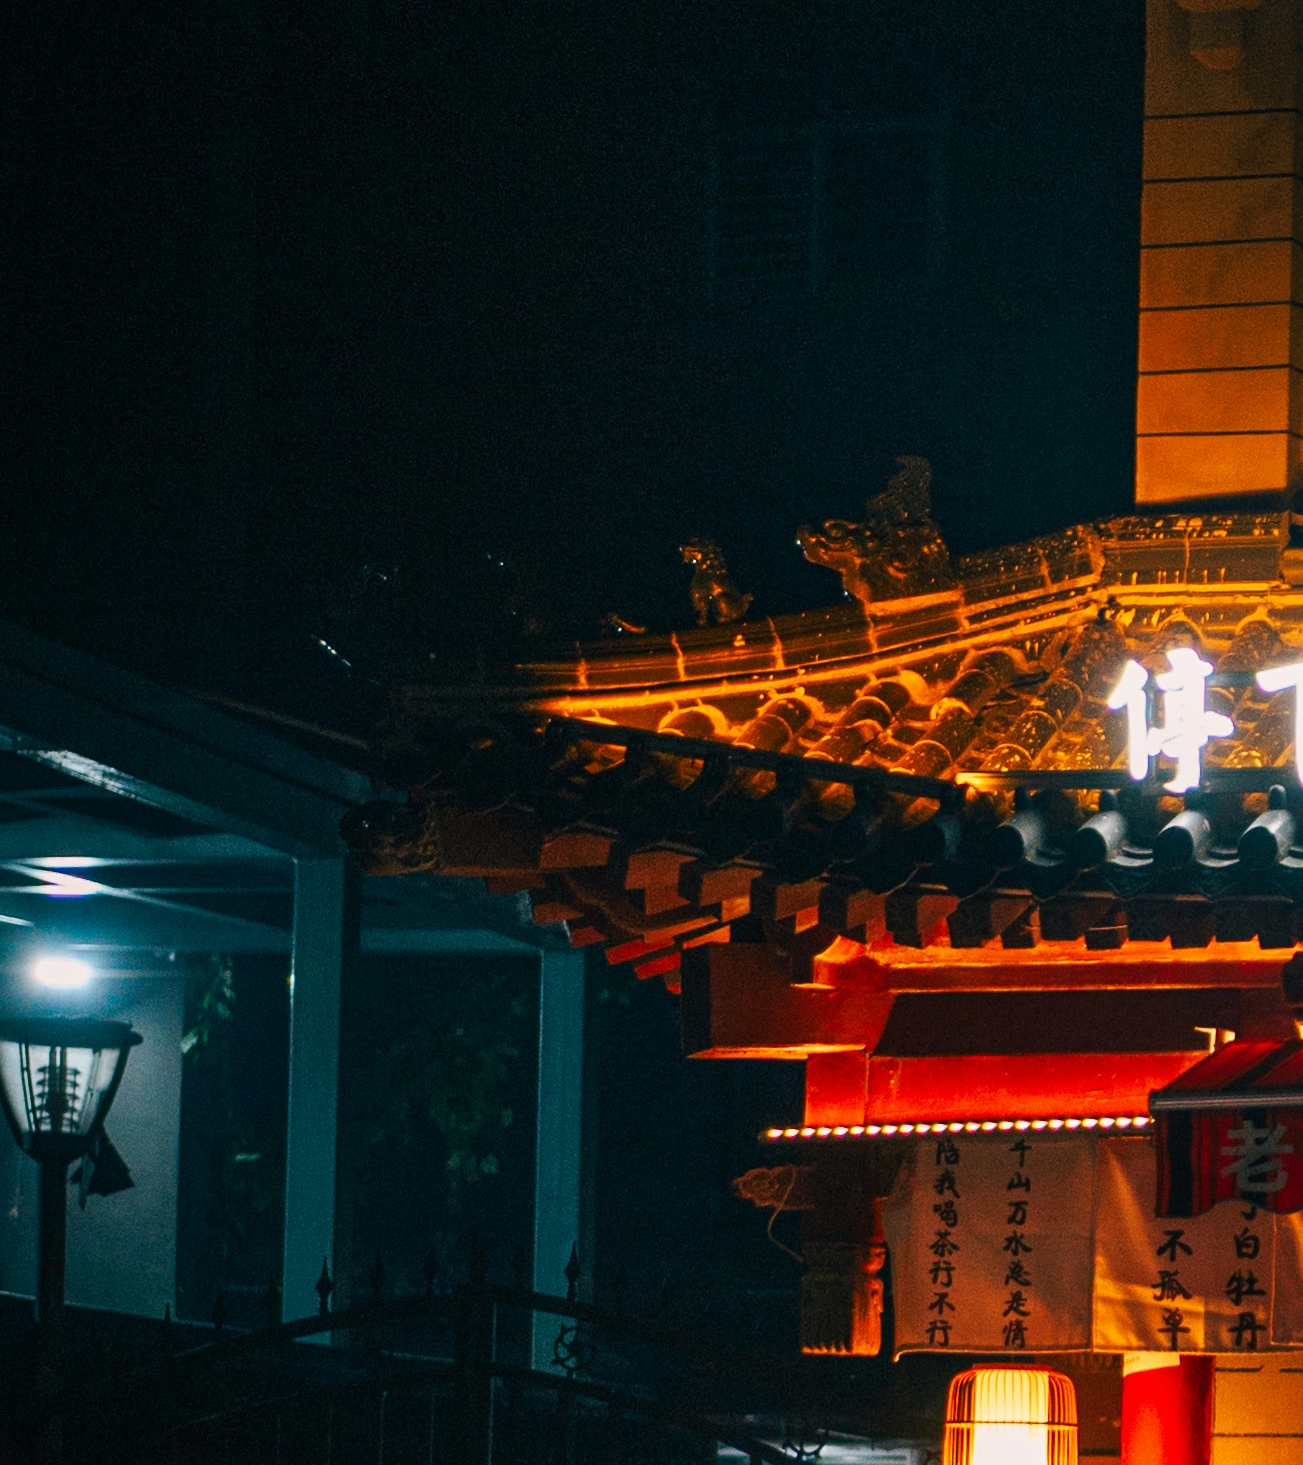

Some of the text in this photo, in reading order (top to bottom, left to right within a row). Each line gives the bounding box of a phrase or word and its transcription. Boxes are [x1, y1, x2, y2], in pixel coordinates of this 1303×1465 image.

[925, 1138, 961, 1348] 陪我喝茶行不行
[1002, 1137, 1033, 1350] 千山万水总是情
[1152, 1229, 1193, 1352] 不孤单
[1226, 1205, 1267, 1351] 白牡丹
